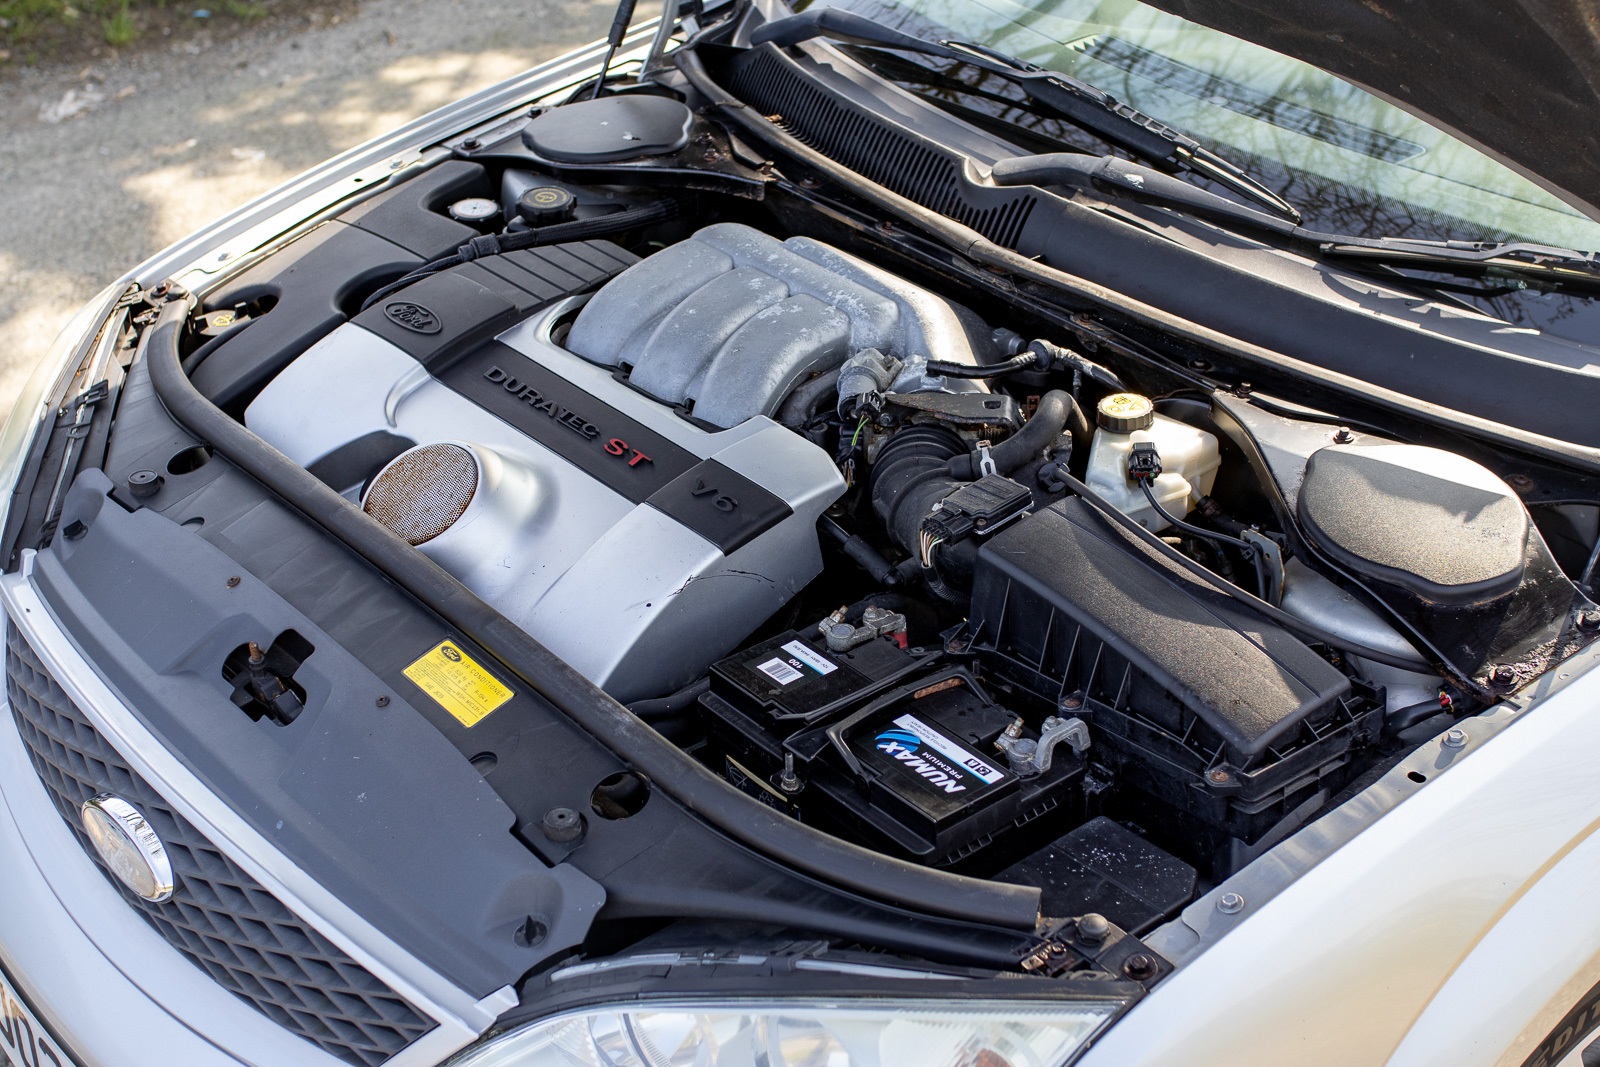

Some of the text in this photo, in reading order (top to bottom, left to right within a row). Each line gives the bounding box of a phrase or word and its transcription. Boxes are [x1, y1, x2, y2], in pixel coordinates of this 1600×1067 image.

[391, 303, 433, 329] Ford
[483, 365, 654, 469] DURATEC ST
[689, 475, 739, 513] V6
[442, 648, 460, 662] Ford
[459, 660, 470, 669] AIR
[468, 669, 507, 698] CONDITIONER
[877, 741, 966, 794] NUMAX
[921, 751, 963, 780] PREMIUM
